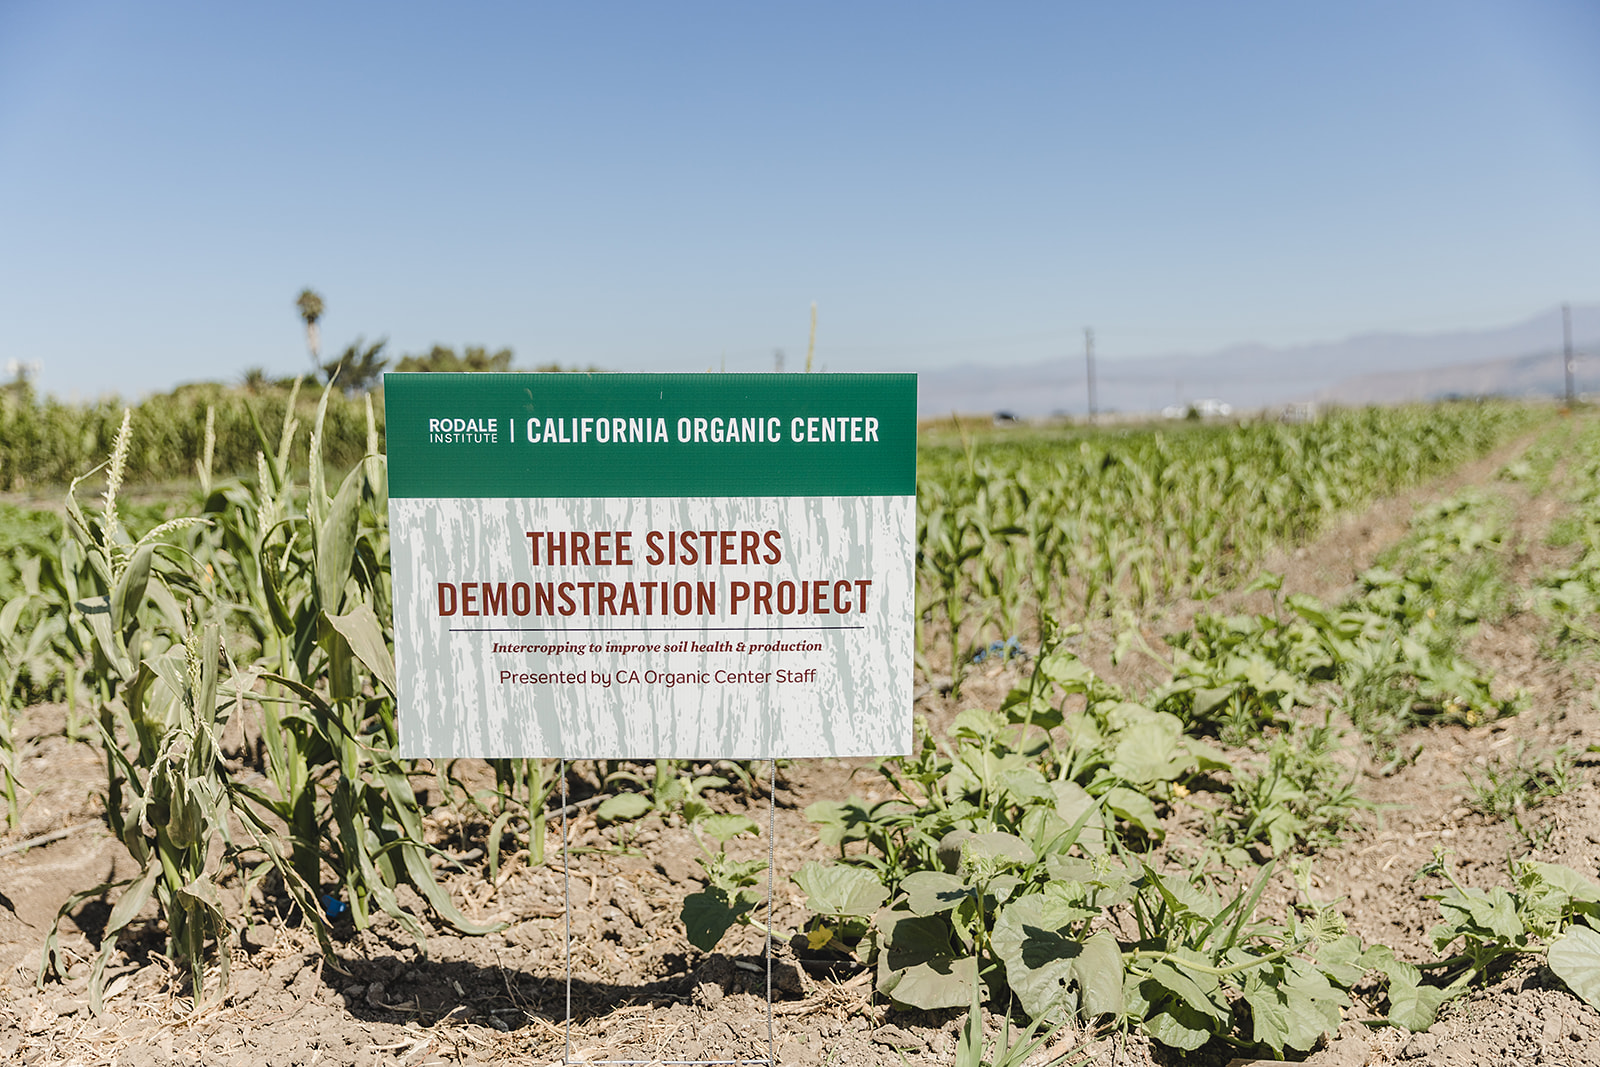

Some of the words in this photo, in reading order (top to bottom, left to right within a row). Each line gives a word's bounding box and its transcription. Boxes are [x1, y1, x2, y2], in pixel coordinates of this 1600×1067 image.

[430, 419, 497, 432] RODALE
[527, 418, 668, 443] CALIFORNIA
[678, 418, 780, 442] ORGANIC
[791, 417, 878, 442] CENTER
[430, 434, 497, 443] INSTITUTE
[527, 532, 633, 565] THREE
[646, 531, 781, 565] SISTERS
[438, 582, 715, 616] DEMONSTRATION
[731, 580, 872, 615] PROJECT
[493, 642, 586, 655] Intercropping
[590, 644, 602, 652] to
[606, 642, 660, 655] improve
[664, 641, 688, 652] soil
[691, 641, 732, 652] health
[736, 642, 745, 651] &
[749, 640, 821, 654] production
[501, 671, 586, 684] Presented
[592, 671, 611, 687] by
[616, 671, 639, 683] CA
[645, 670, 709, 687] Organic
[715, 670, 771, 683] Center
[776, 669, 816, 683] Staff
